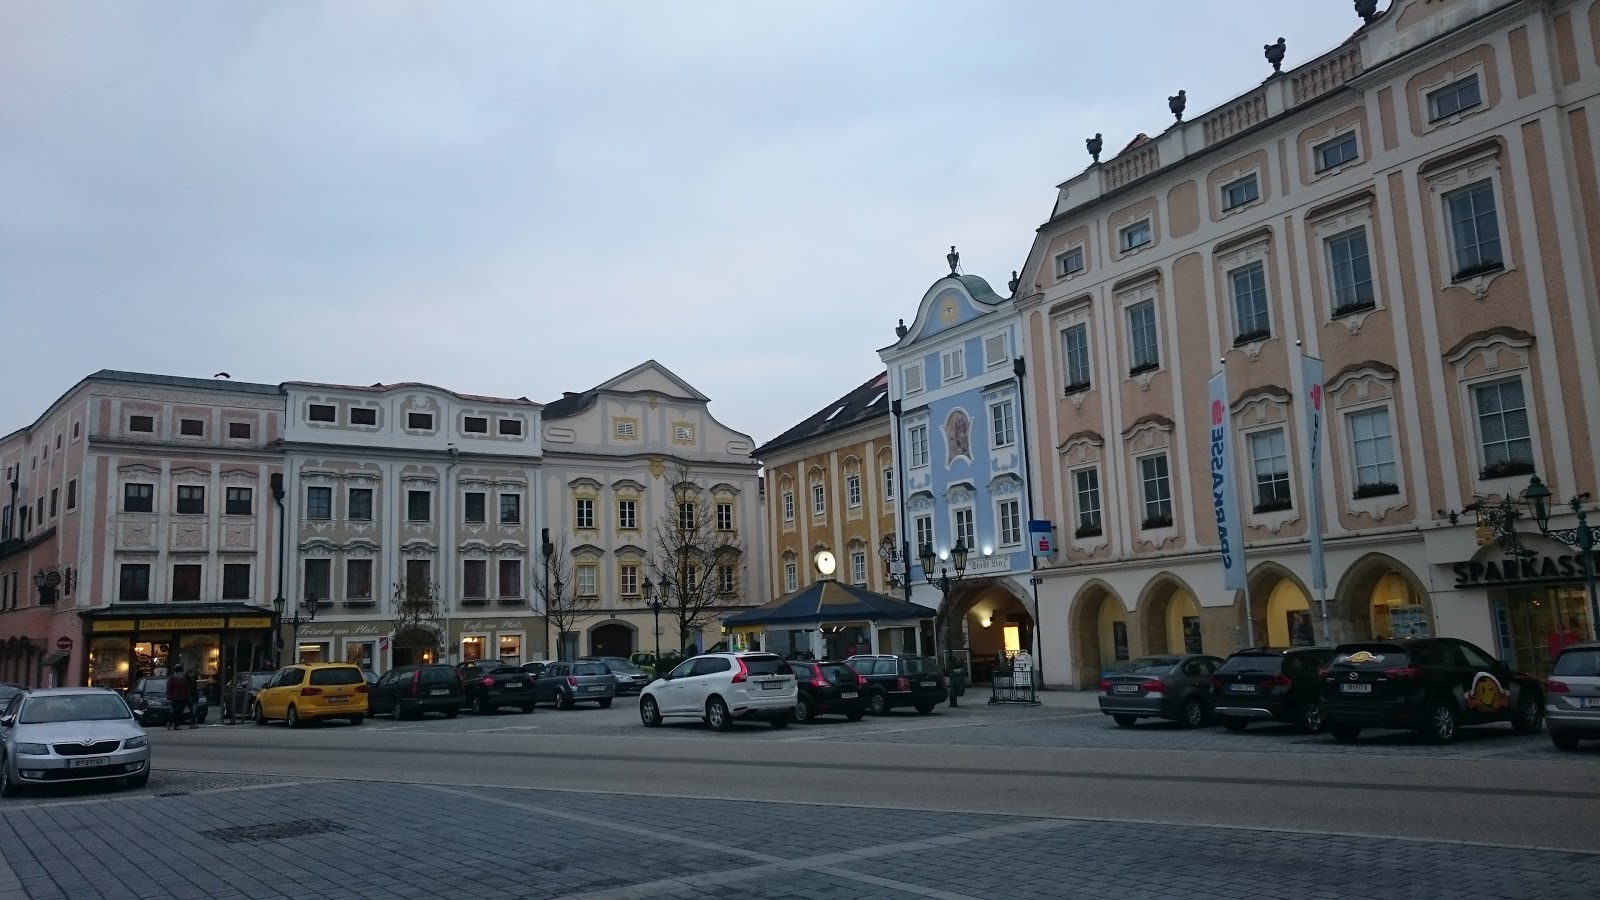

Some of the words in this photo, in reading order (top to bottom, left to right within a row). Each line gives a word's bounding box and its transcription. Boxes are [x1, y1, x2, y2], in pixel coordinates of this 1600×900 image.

[1453, 553, 1600, 583] SPARKASS
[174, 618, 221, 627] Naturladen
[499, 620, 523, 629] Platz
[297, 625, 332, 636] Friseur
[351, 624, 380, 634] Platz
